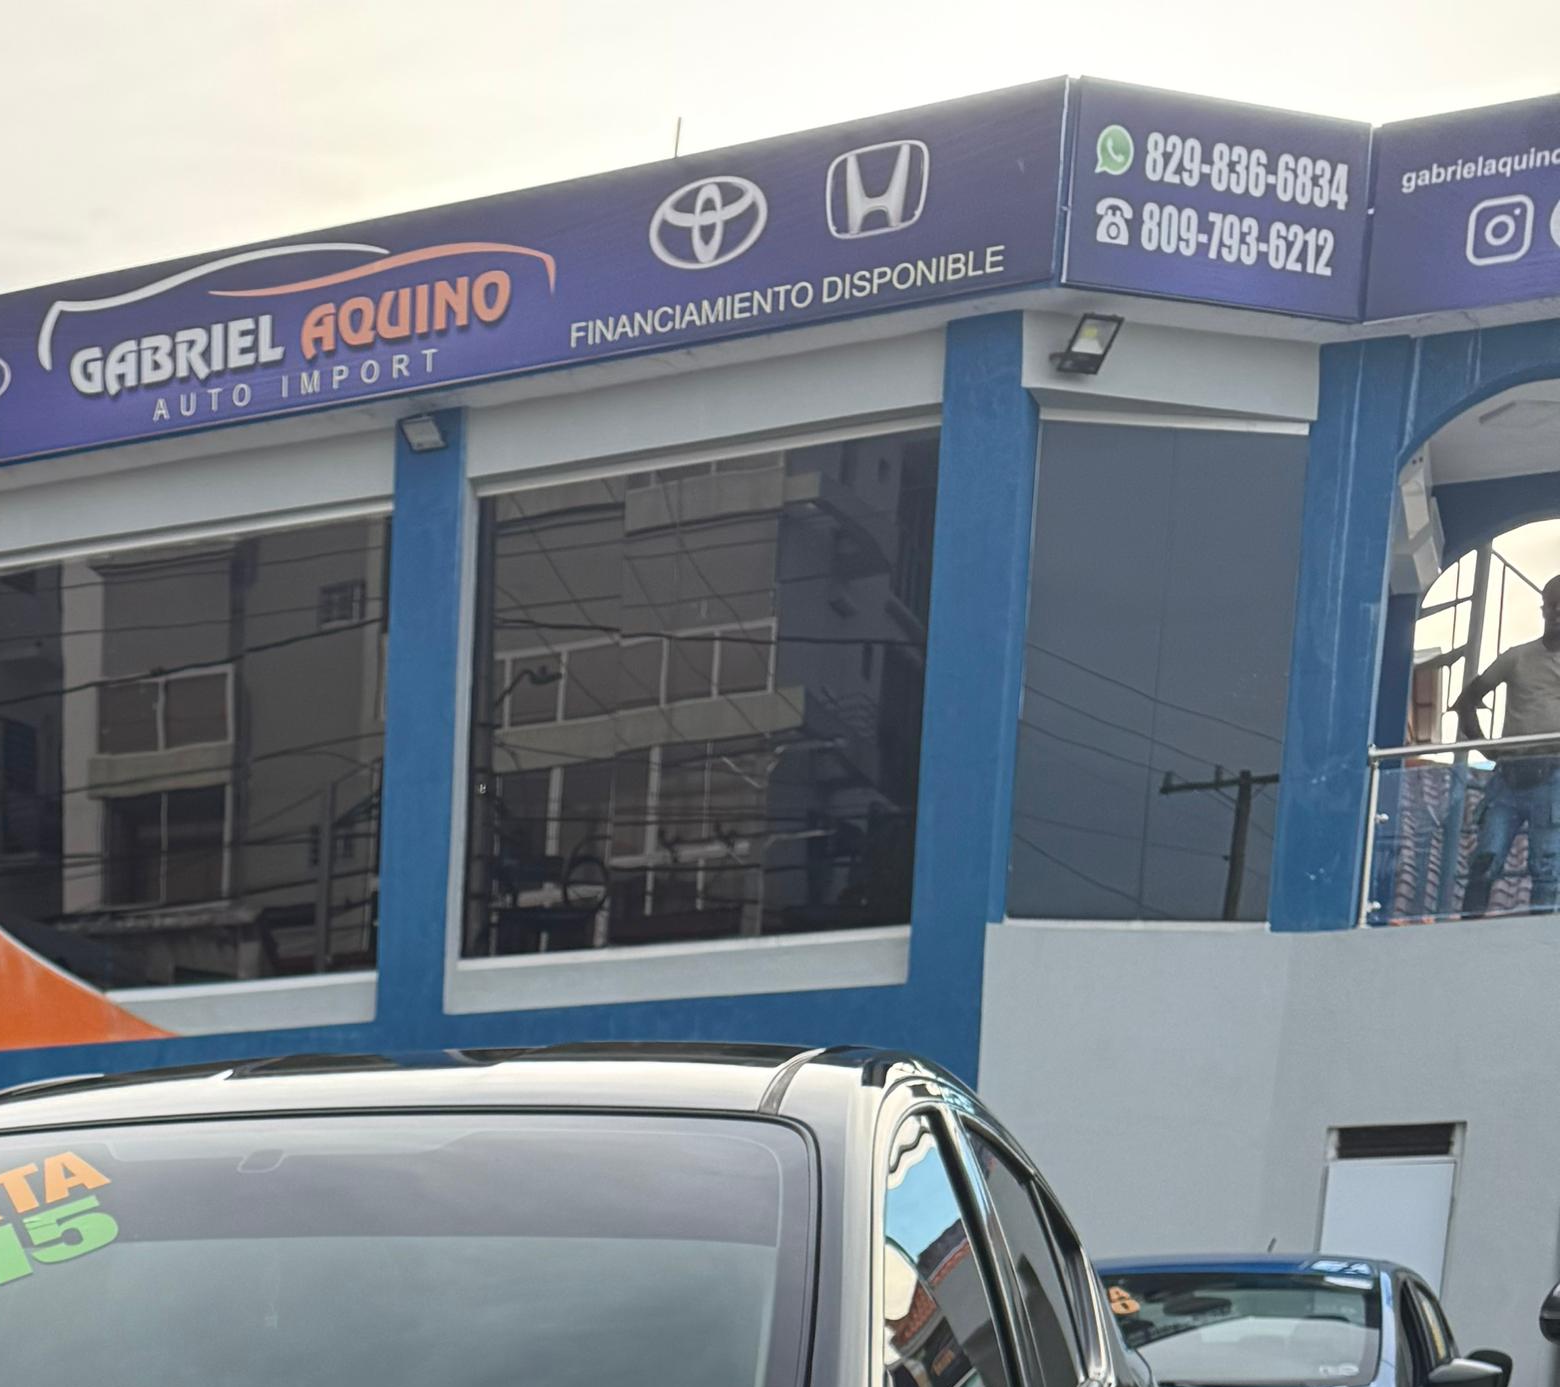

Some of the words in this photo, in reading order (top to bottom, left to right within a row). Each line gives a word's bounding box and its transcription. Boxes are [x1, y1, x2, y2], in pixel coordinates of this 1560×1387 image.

[1144, 131, 1350, 211] 829-836-6834
[1140, 201, 1335, 277] 809-793-6212
[69, 313, 286, 397] GABRIEL
[300, 269, 512, 361] AQUINO
[569, 281, 814, 349] FINANCIAMIENTO
[821, 244, 1006, 304] DISPONIBLE
[153, 382, 252, 422] AUTO
[282, 347, 440, 397] IMPORT
